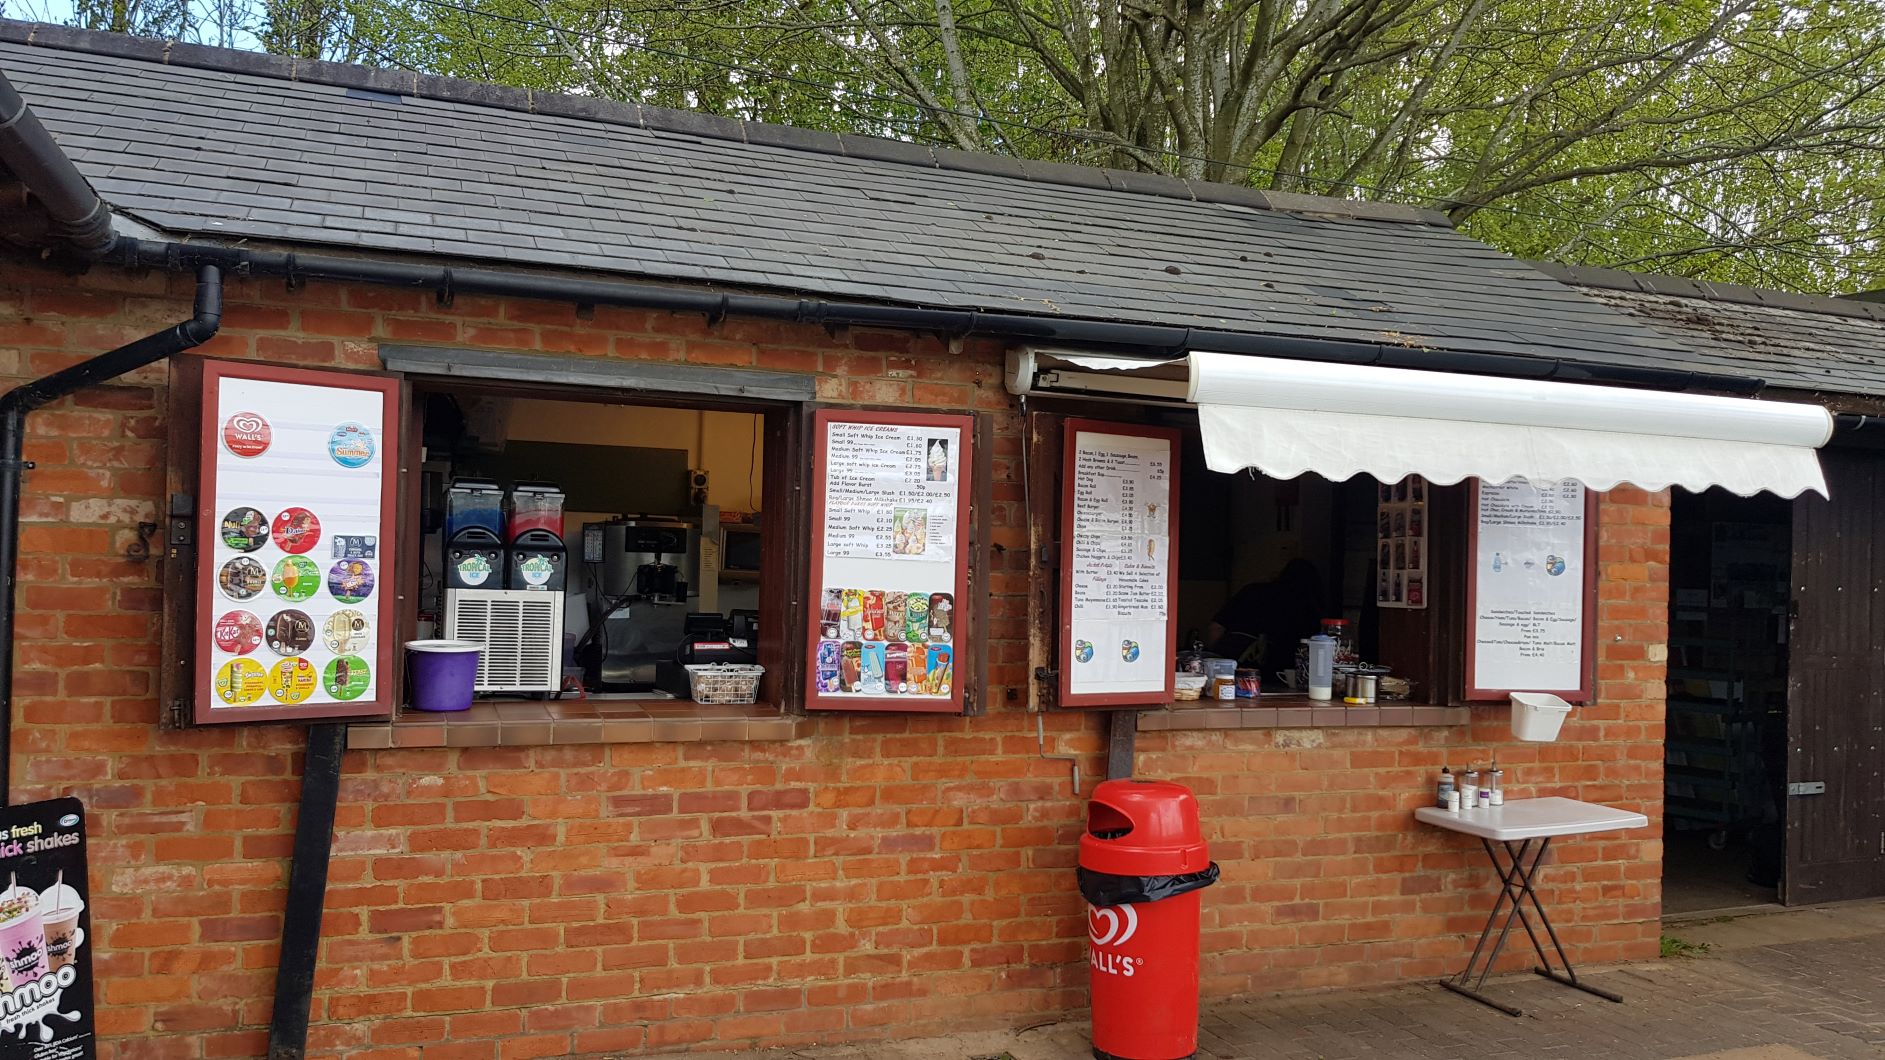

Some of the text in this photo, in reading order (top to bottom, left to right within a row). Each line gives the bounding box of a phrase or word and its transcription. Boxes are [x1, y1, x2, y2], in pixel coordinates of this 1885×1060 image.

[336, 447, 369, 456] Summer
[458, 562, 491, 572] TROPICAL
[521, 562, 553, 572] TROPICAL
[220, 626, 239, 640] KitKat
[0, 821, 42, 840] s fresh
[0, 832, 80, 858] ick shakes
[47, 940, 72, 952] shmoo
[10, 948, 43, 969] shmoo
[1090, 946, 1134, 976] ALL'S
[6, 997, 55, 1024] fresh thick shakes
